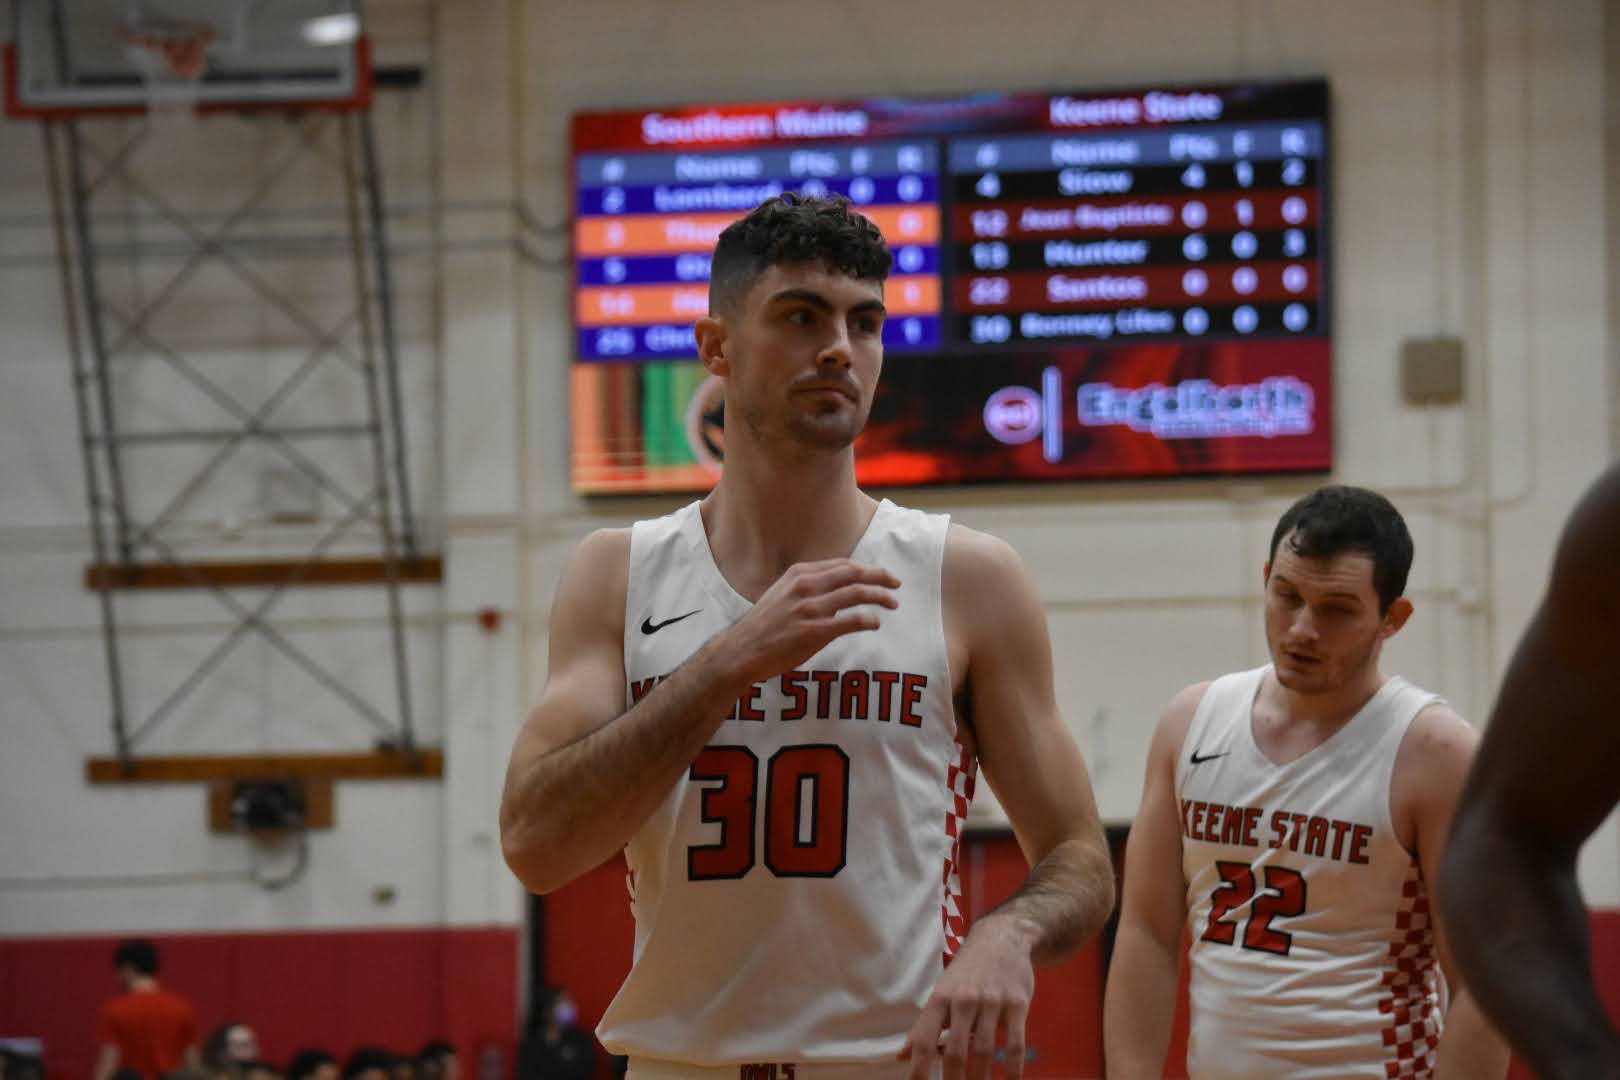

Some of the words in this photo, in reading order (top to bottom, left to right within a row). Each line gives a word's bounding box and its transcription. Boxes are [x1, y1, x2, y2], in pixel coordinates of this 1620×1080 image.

[1050, 98, 1140, 125] Keene
[1144, 93, 1221, 121] State
[642, 113, 772, 143] Southern
[776, 110, 867, 137] Maine
[675, 156, 762, 181] Name
[789, 150, 839, 177] Pts
[1051, 140, 1140, 165] Name
[1169, 134, 1219, 160] Pts
[976, 172, 1000, 197] 4
[1182, 163, 1206, 188] 4
[1182, 201, 1208, 228] 0
[1281, 196, 1307, 223] 0
[1044, 240, 1147, 266] Hunter
[1232, 232, 1258, 259] 0
[1047, 276, 1147, 302] Santos
[1182, 269, 1208, 296] 0
[1232, 267, 1258, 294] 0
[1282, 265, 1307, 292] 0
[1183, 307, 1209, 335] 0
[1233, 305, 1259, 333] 0
[1283, 303, 1308, 331] 0
[780, 669, 928, 728] STATE
[688, 743, 850, 881] 30
[1182, 798, 1264, 848] KEENE
[1268, 810, 1374, 865] STATE
[1200, 860, 1307, 956] 22
